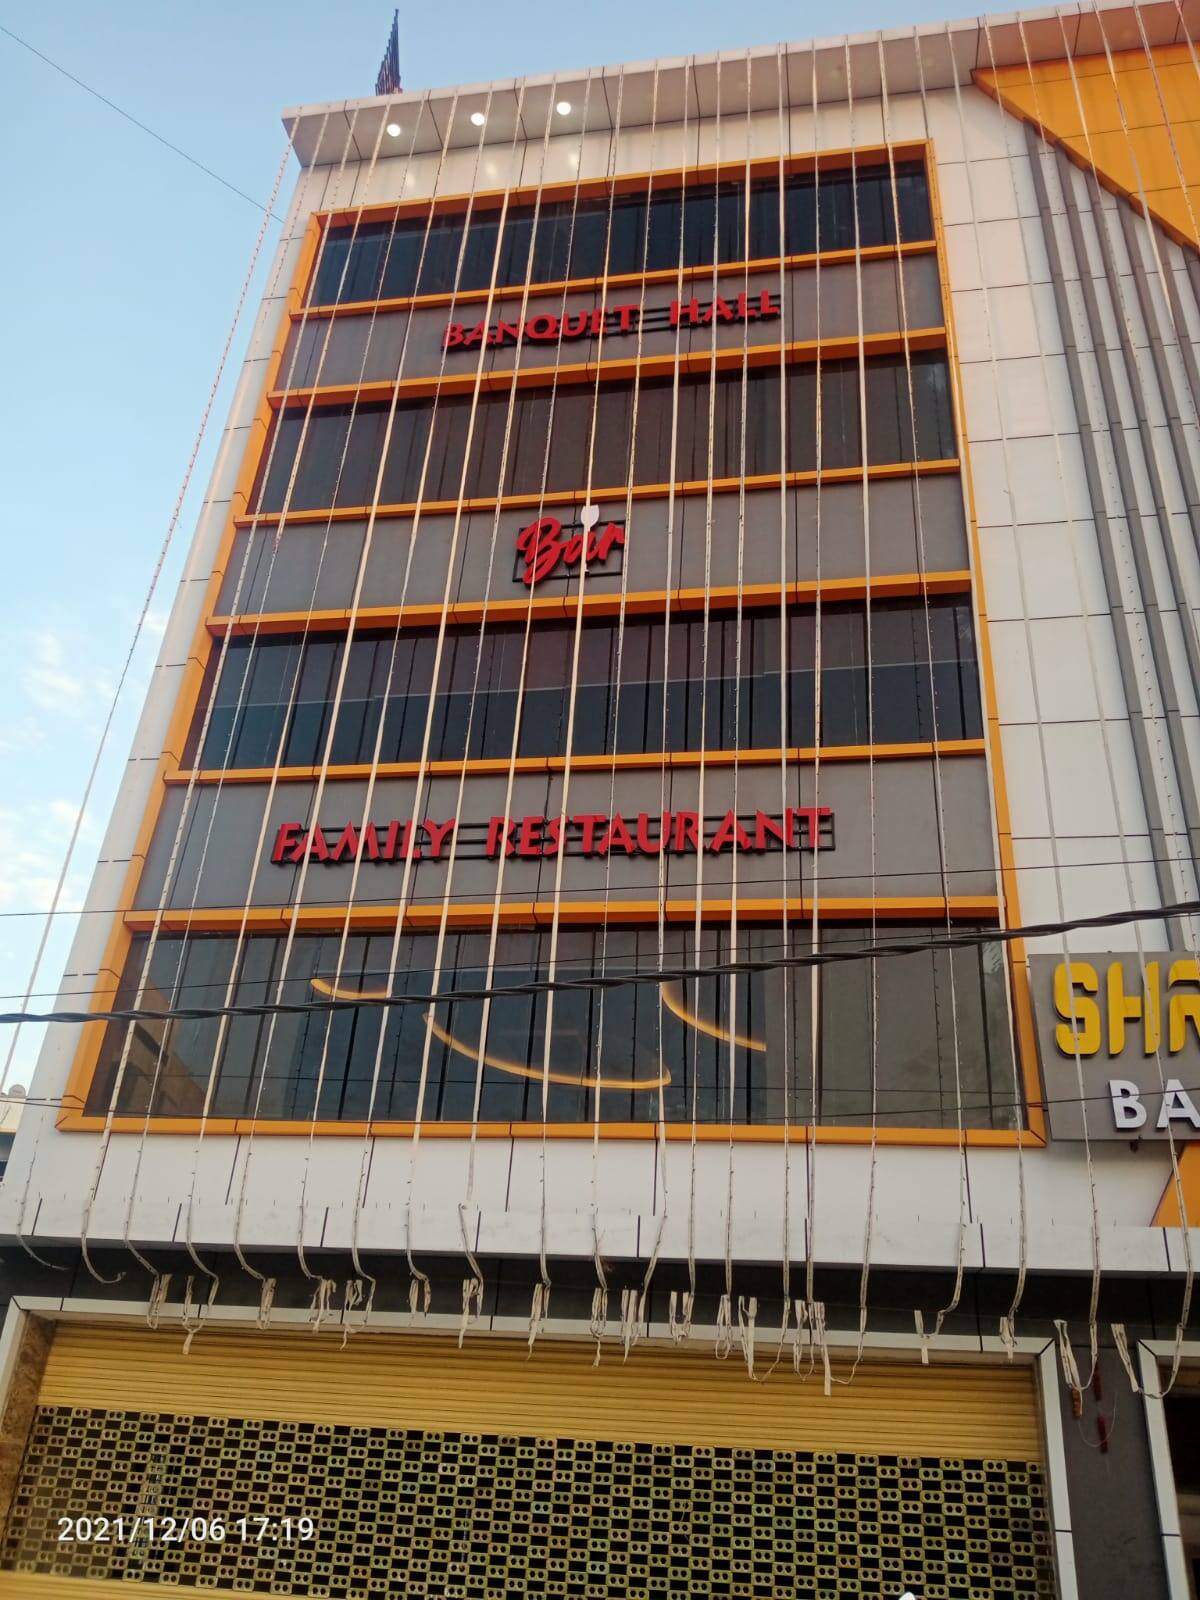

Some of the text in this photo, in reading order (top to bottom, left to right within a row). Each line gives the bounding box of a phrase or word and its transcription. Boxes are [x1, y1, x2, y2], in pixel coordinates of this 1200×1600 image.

[443, 289, 779, 347] BANQUET HALL
[516, 516, 625, 585] Bar
[273, 807, 832, 862] FAMILY RESTAURANT
